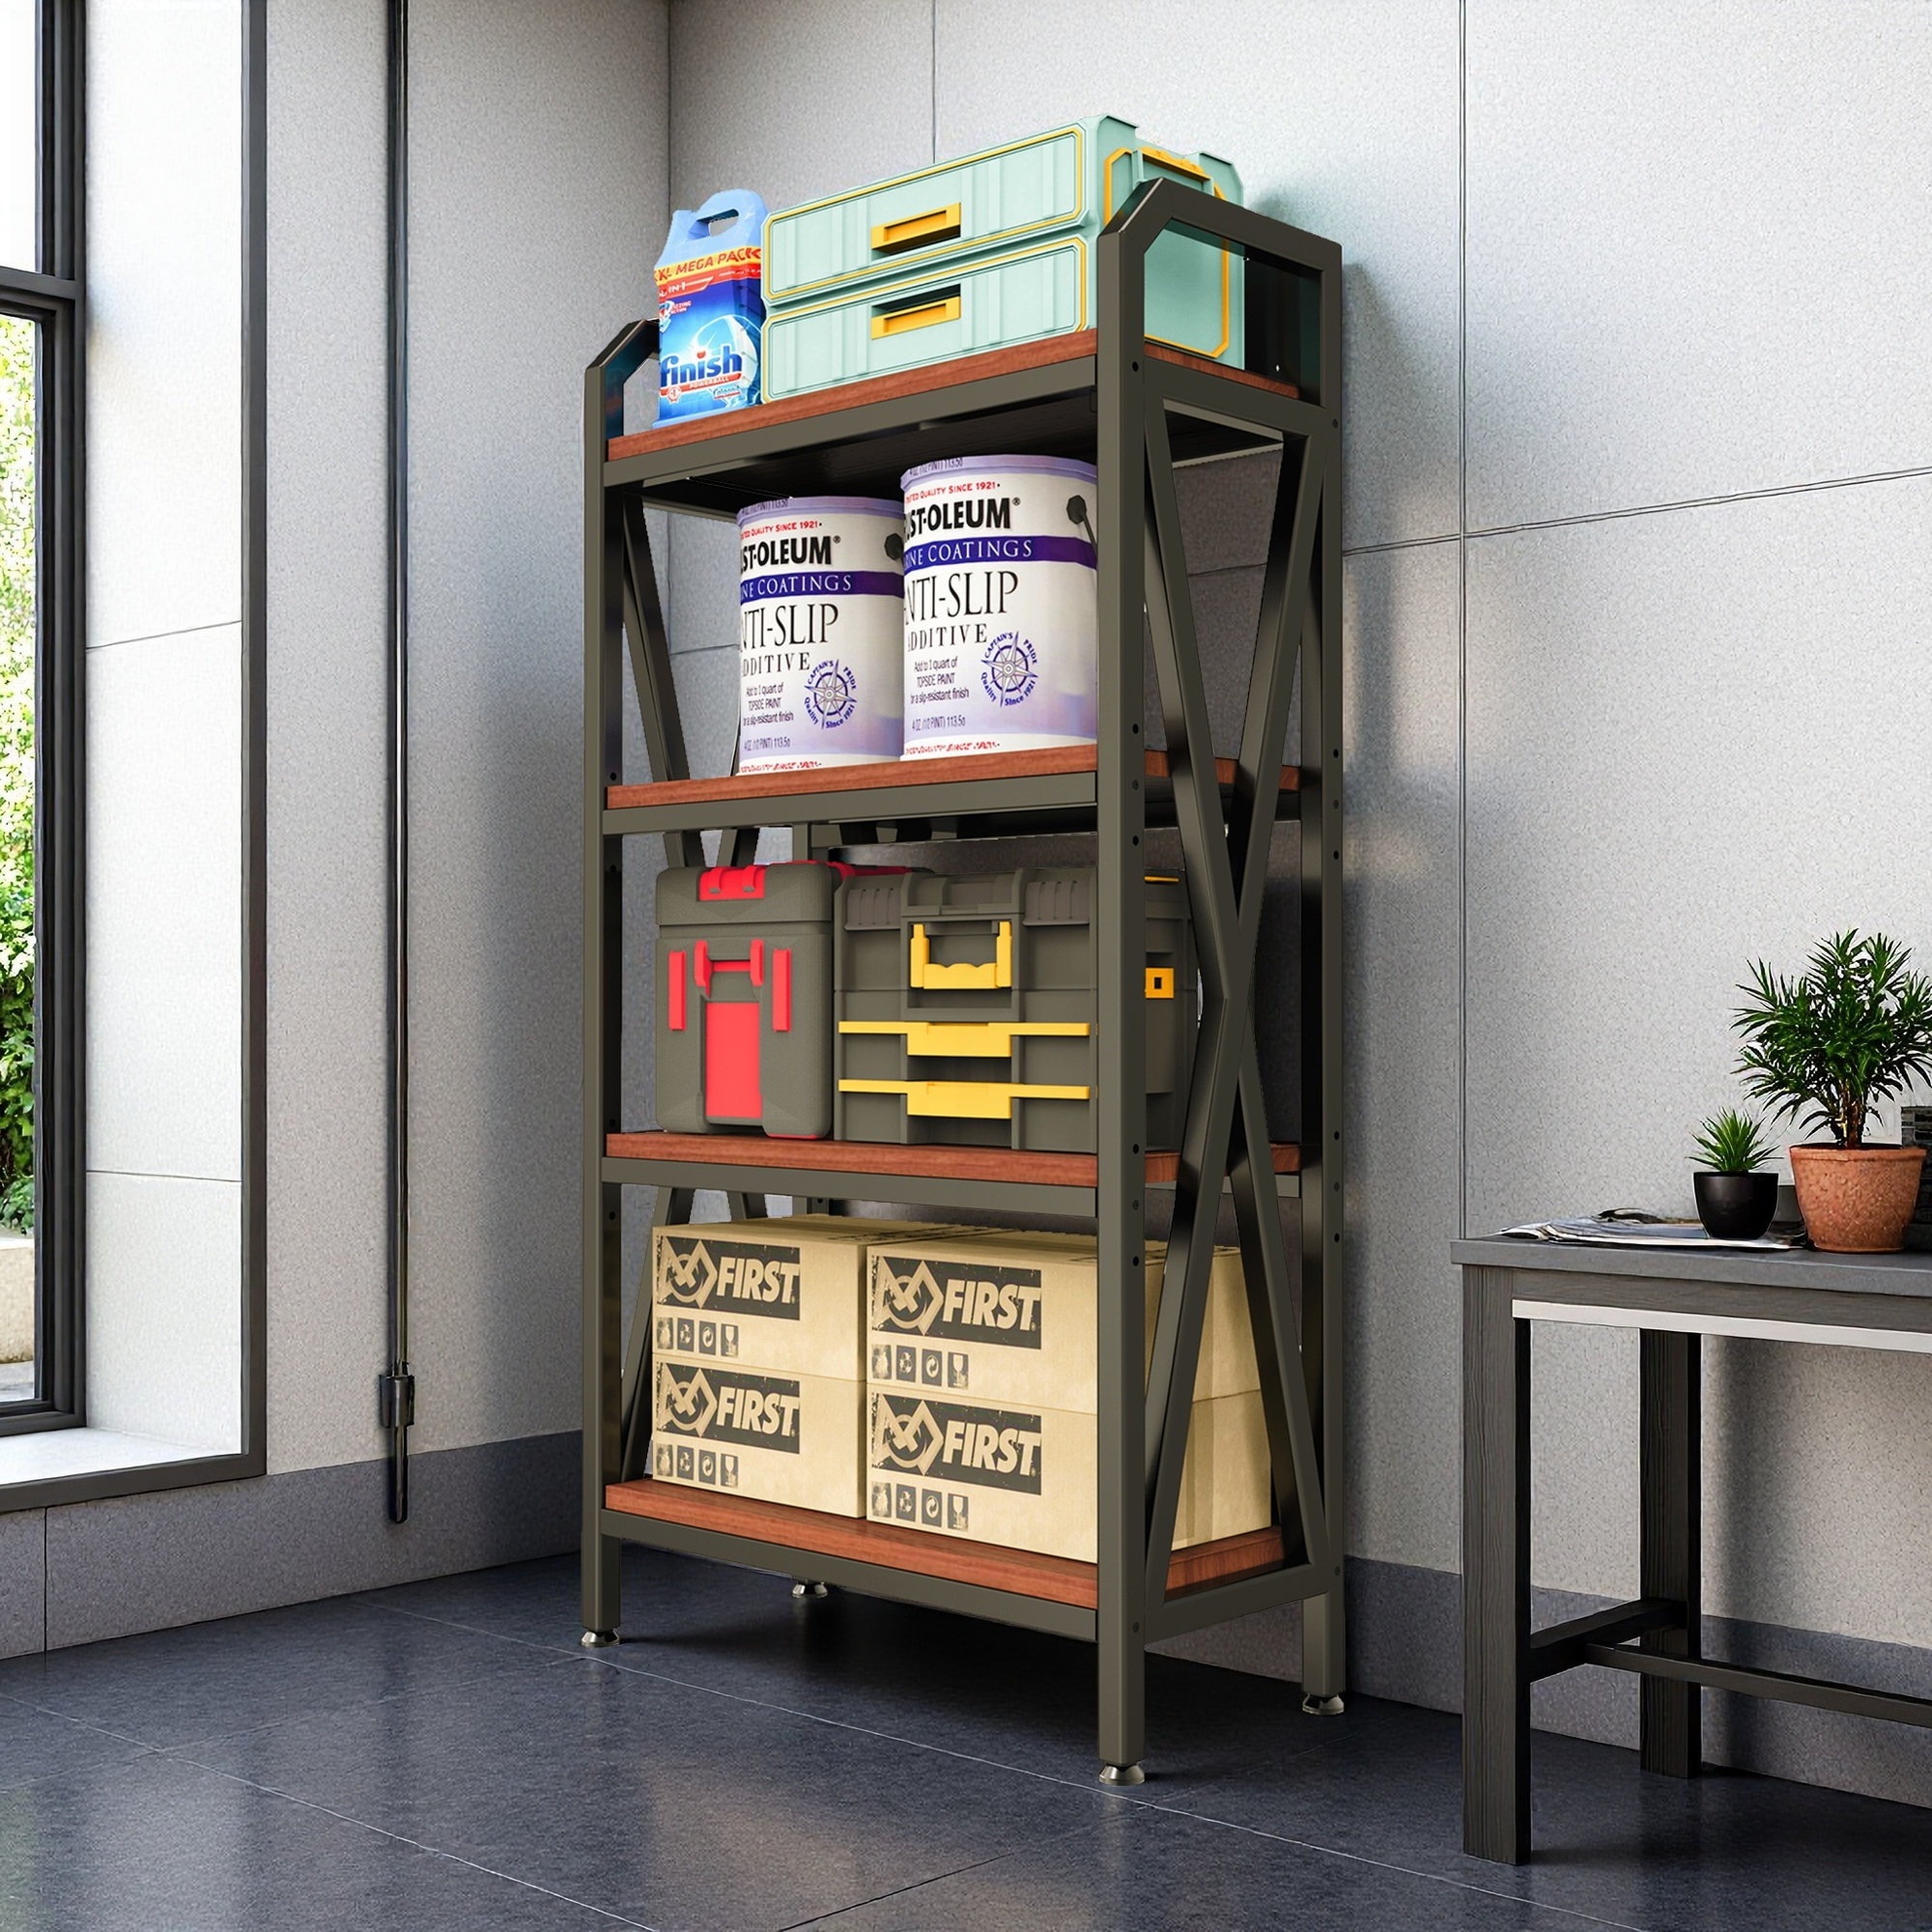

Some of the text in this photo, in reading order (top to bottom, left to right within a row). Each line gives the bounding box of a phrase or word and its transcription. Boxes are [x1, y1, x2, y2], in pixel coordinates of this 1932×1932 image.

[676, 256, 713, 275] MEGA
[668, 284, 680, 293] IN
[661, 345, 743, 388] finish
[921, 487, 946, 499] QUALITY
[948, 483, 973, 495] SINCE
[976, 481, 996, 491] 1921
[752, 526, 774, 537] QUALITY
[776, 522, 797, 532] SINCE
[800, 521, 818, 529] 1921
[906, 497, 1011, 539] ST-OLEUM
[927, 539, 1033, 562] COATINGS
[757, 574, 851, 595] COATINGS
[905, 570, 1019, 623] NTI-SLIP
[741, 603, 838, 651] NTI-SLIP
[908, 623, 987, 651] DDITIVE
[984, 632, 1013, 659] CAPTAIN'S
[743, 652, 810, 677] DDITIVE
[932, 659, 951, 671] quart
[951, 656, 958, 668] of
[761, 684, 778, 696] quart
[778, 682, 784, 694] of
[937, 672, 955, 685] PAINT
[980, 671, 997, 702] Quality
[1024, 679, 1036, 697] 1921
[765, 696, 781, 709] PAINT
[804, 696, 819, 724] Quality
[716, 1257, 801, 1306] FIRST
[942, 1279, 1042, 1333] FIRST
[716, 1386, 801, 1439] FIRST
[942, 1422, 1042, 1478] FIRST
